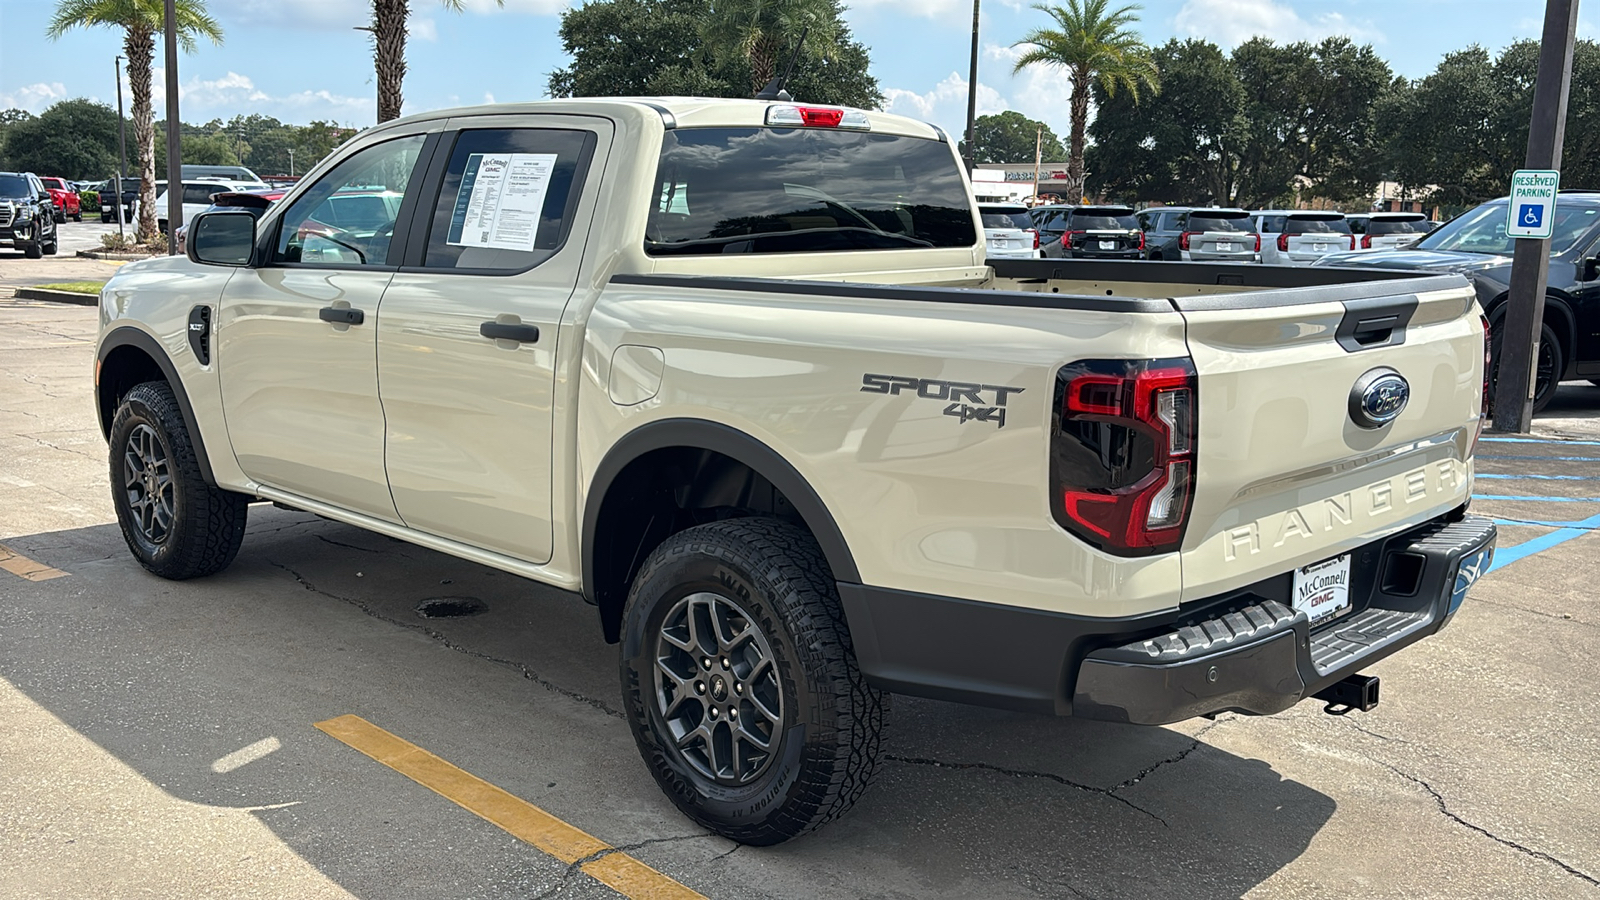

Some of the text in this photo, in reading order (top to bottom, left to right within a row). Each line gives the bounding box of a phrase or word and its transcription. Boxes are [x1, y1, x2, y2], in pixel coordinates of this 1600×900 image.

[1515, 177, 1556, 186] RESERVED
[1516, 188, 1552, 198] PARKING
[860, 373, 1026, 407] SPORT
[1375, 386, 1401, 412] Ford
[1223, 459, 1456, 562] RANGER
[1299, 570, 1346, 601] McConnell
[1311, 591, 1334, 607] GMC
[719, 570, 800, 725] WRANGLER
[627, 662, 698, 805] GOODYEAR
[749, 765, 791, 815] TERRITORY
